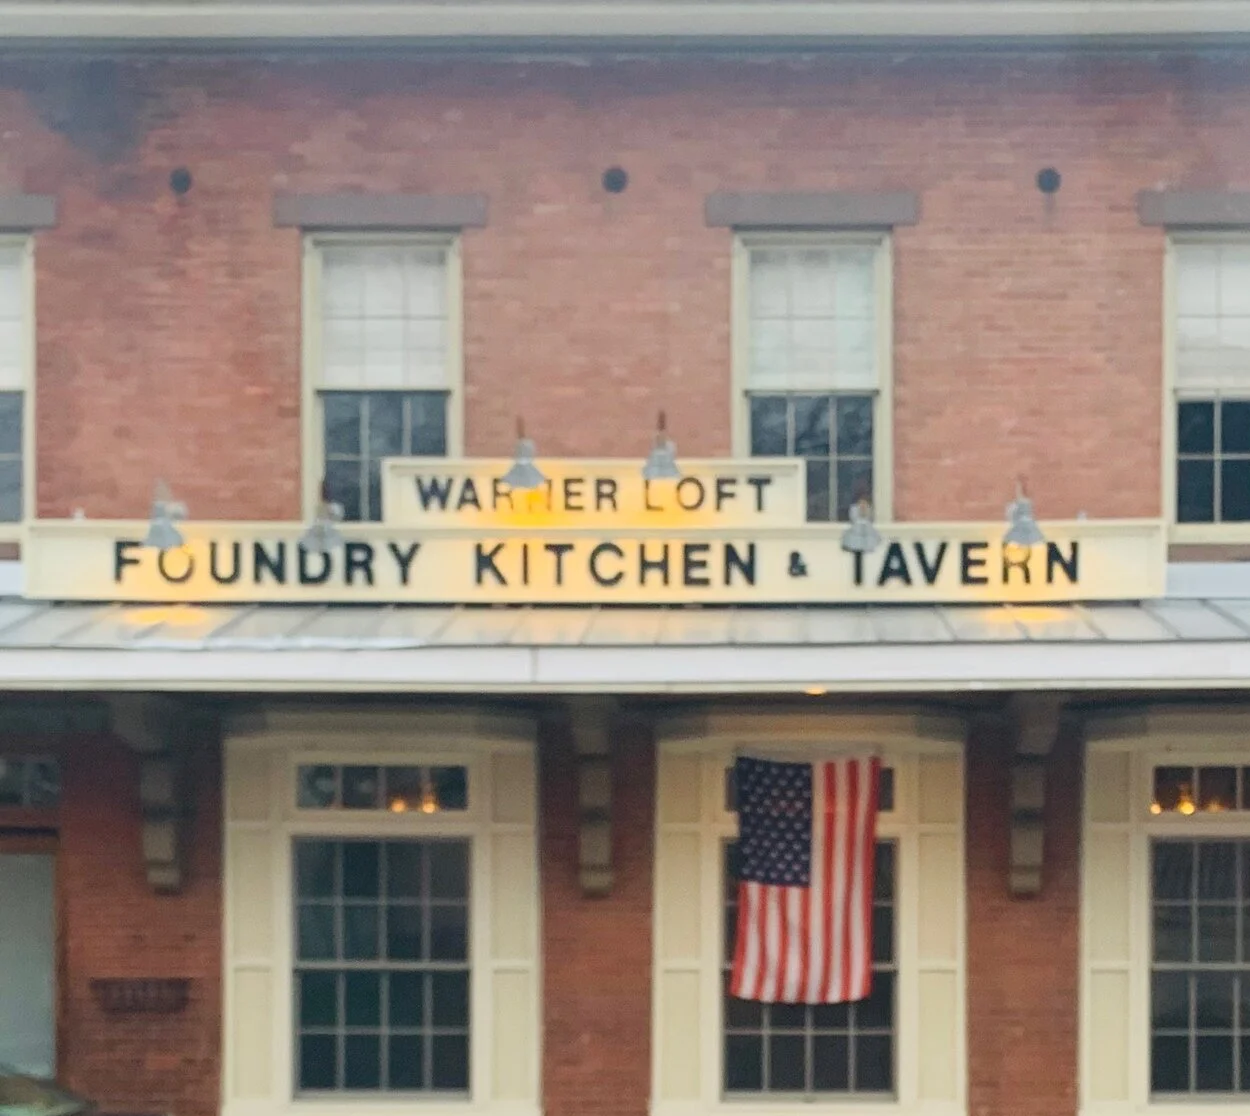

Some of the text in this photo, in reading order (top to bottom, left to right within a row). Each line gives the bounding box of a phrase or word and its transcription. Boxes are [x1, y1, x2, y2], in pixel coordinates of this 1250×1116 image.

[644, 476, 773, 512] LOFT
[113, 541, 421, 587] FOUNDRY
[475, 541, 758, 587] KITCHEN
[788, 550, 809, 577] &
